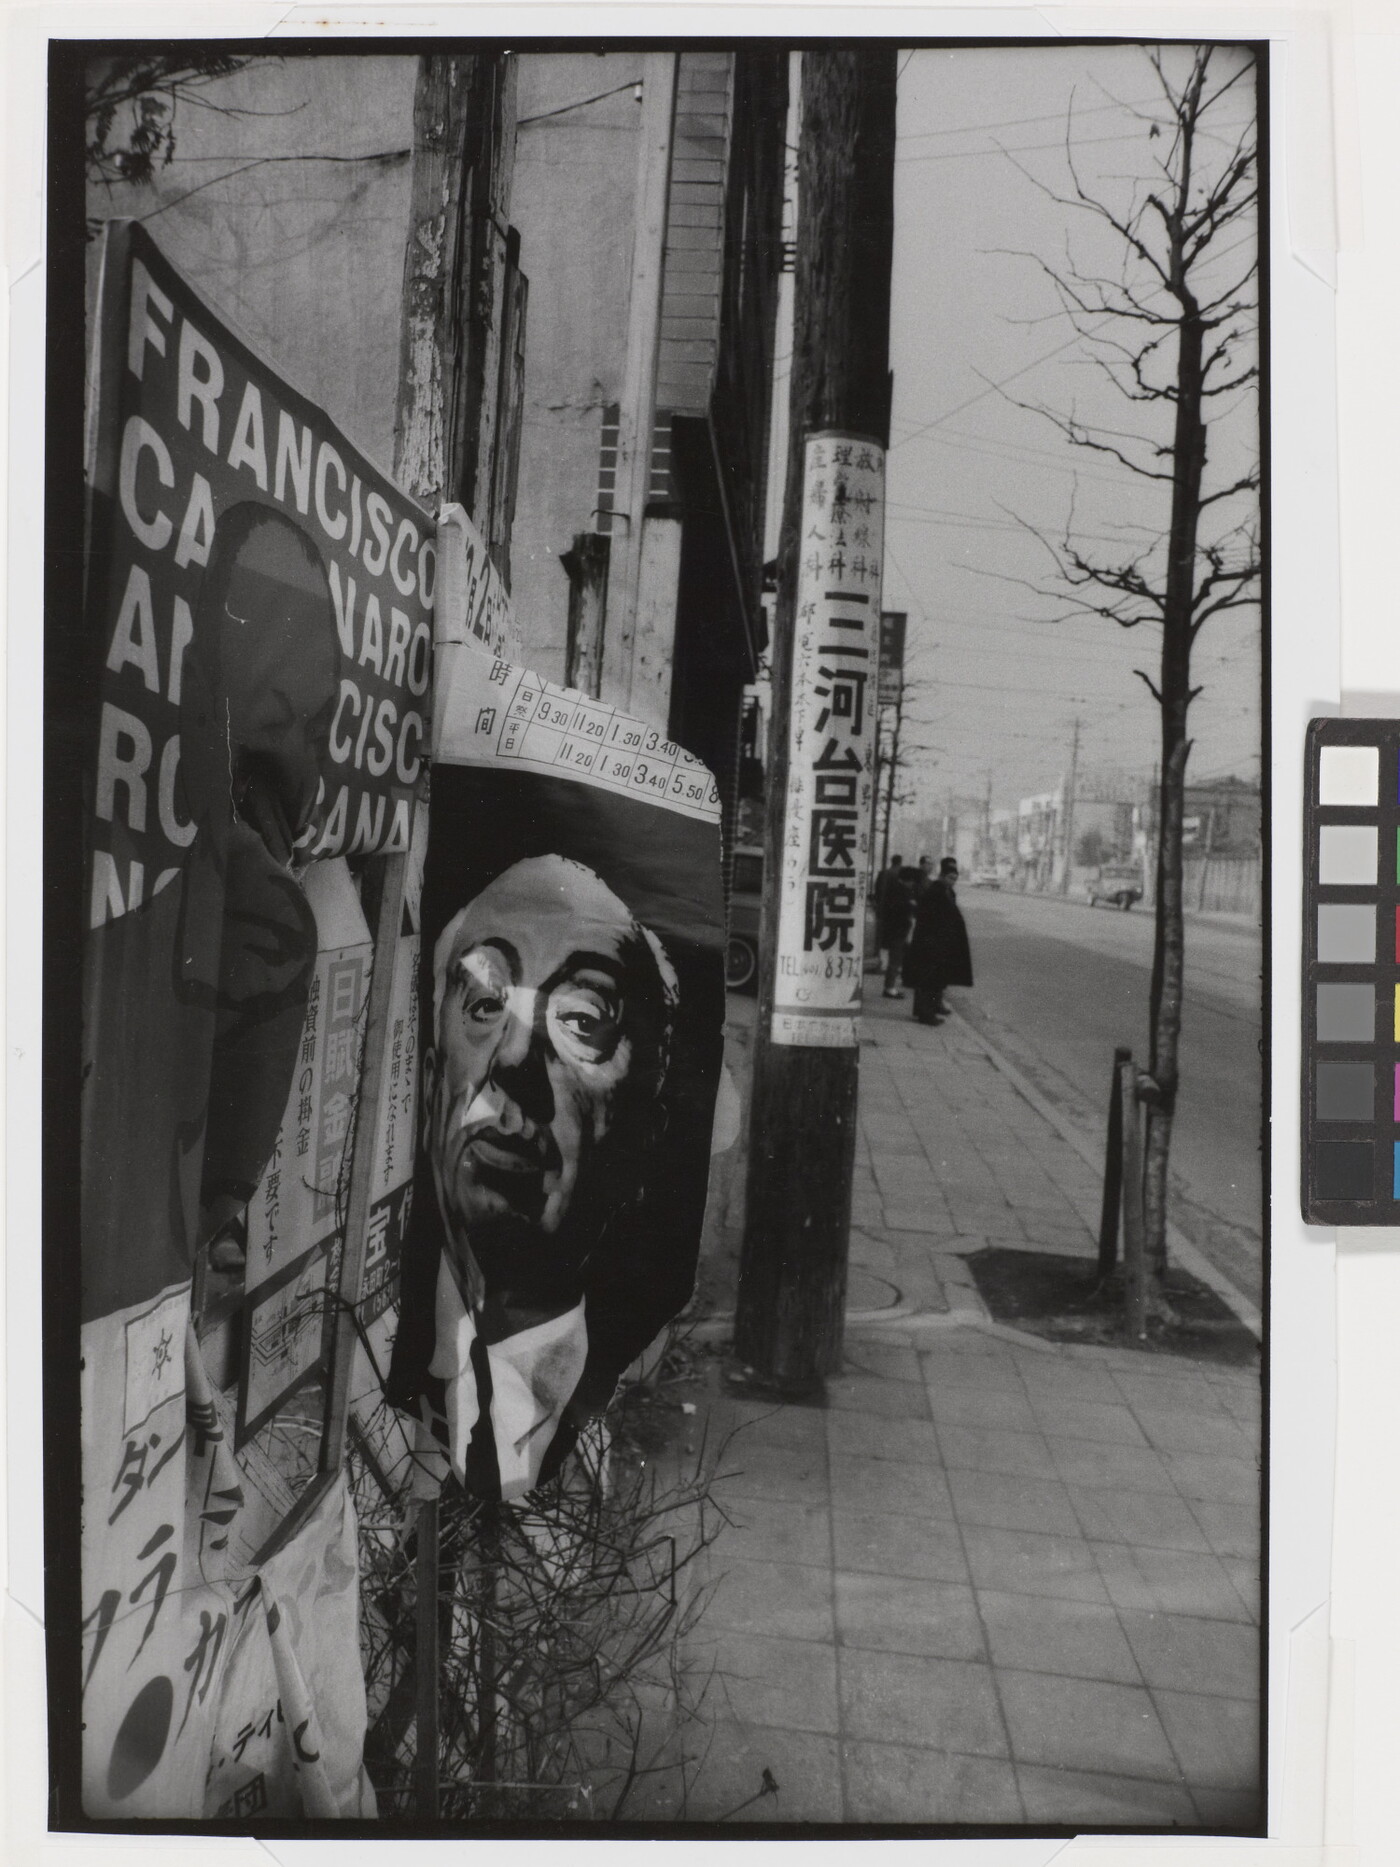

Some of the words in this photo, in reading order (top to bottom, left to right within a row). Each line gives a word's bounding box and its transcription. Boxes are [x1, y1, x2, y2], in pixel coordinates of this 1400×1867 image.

[128, 258, 436, 602] FRANCISCO
[329, 679, 423, 784] CISC
[804, 590, 868, 952] 三河台医院
[780, 956, 799, 976] TEL
